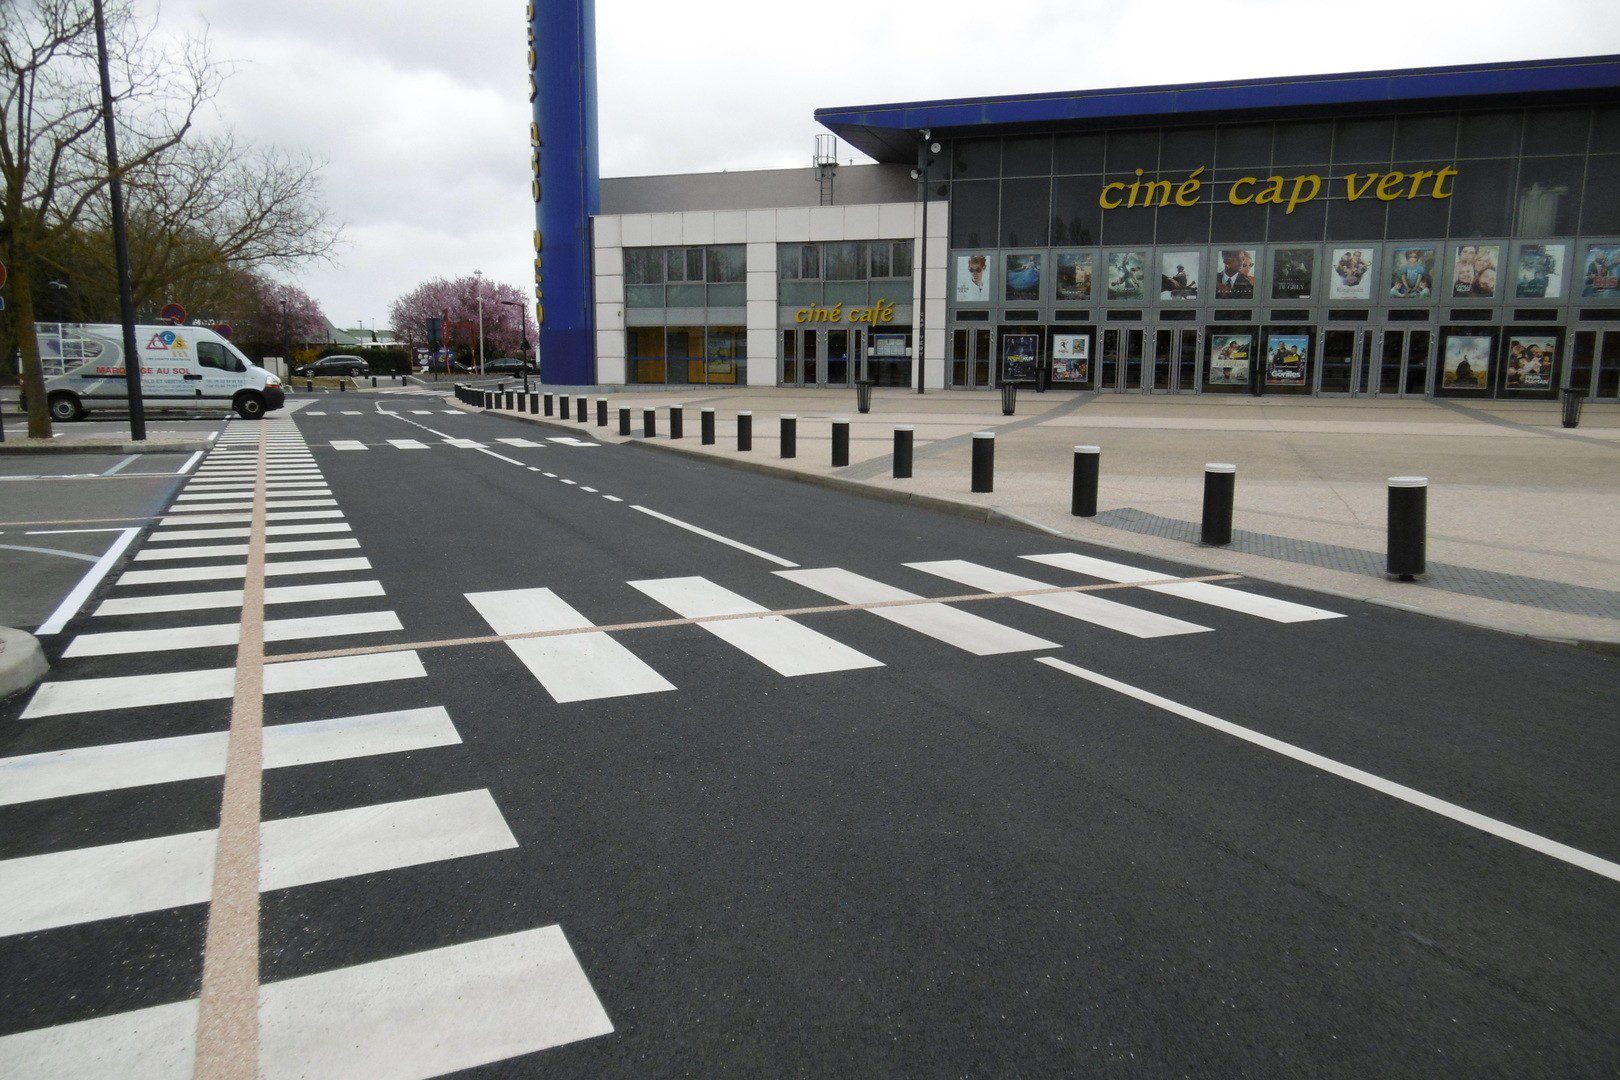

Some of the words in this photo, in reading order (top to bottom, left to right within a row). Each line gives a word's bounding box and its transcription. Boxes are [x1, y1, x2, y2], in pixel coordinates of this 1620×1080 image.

[1099, 165, 1205, 210] ciné
[1228, 174, 1322, 215] cap
[1343, 165, 1458, 202] vert
[795, 302, 843, 323] ciné
[849, 298, 895, 327] café
[156, 367, 170, 375] AU
[172, 367, 191, 375] SOL
